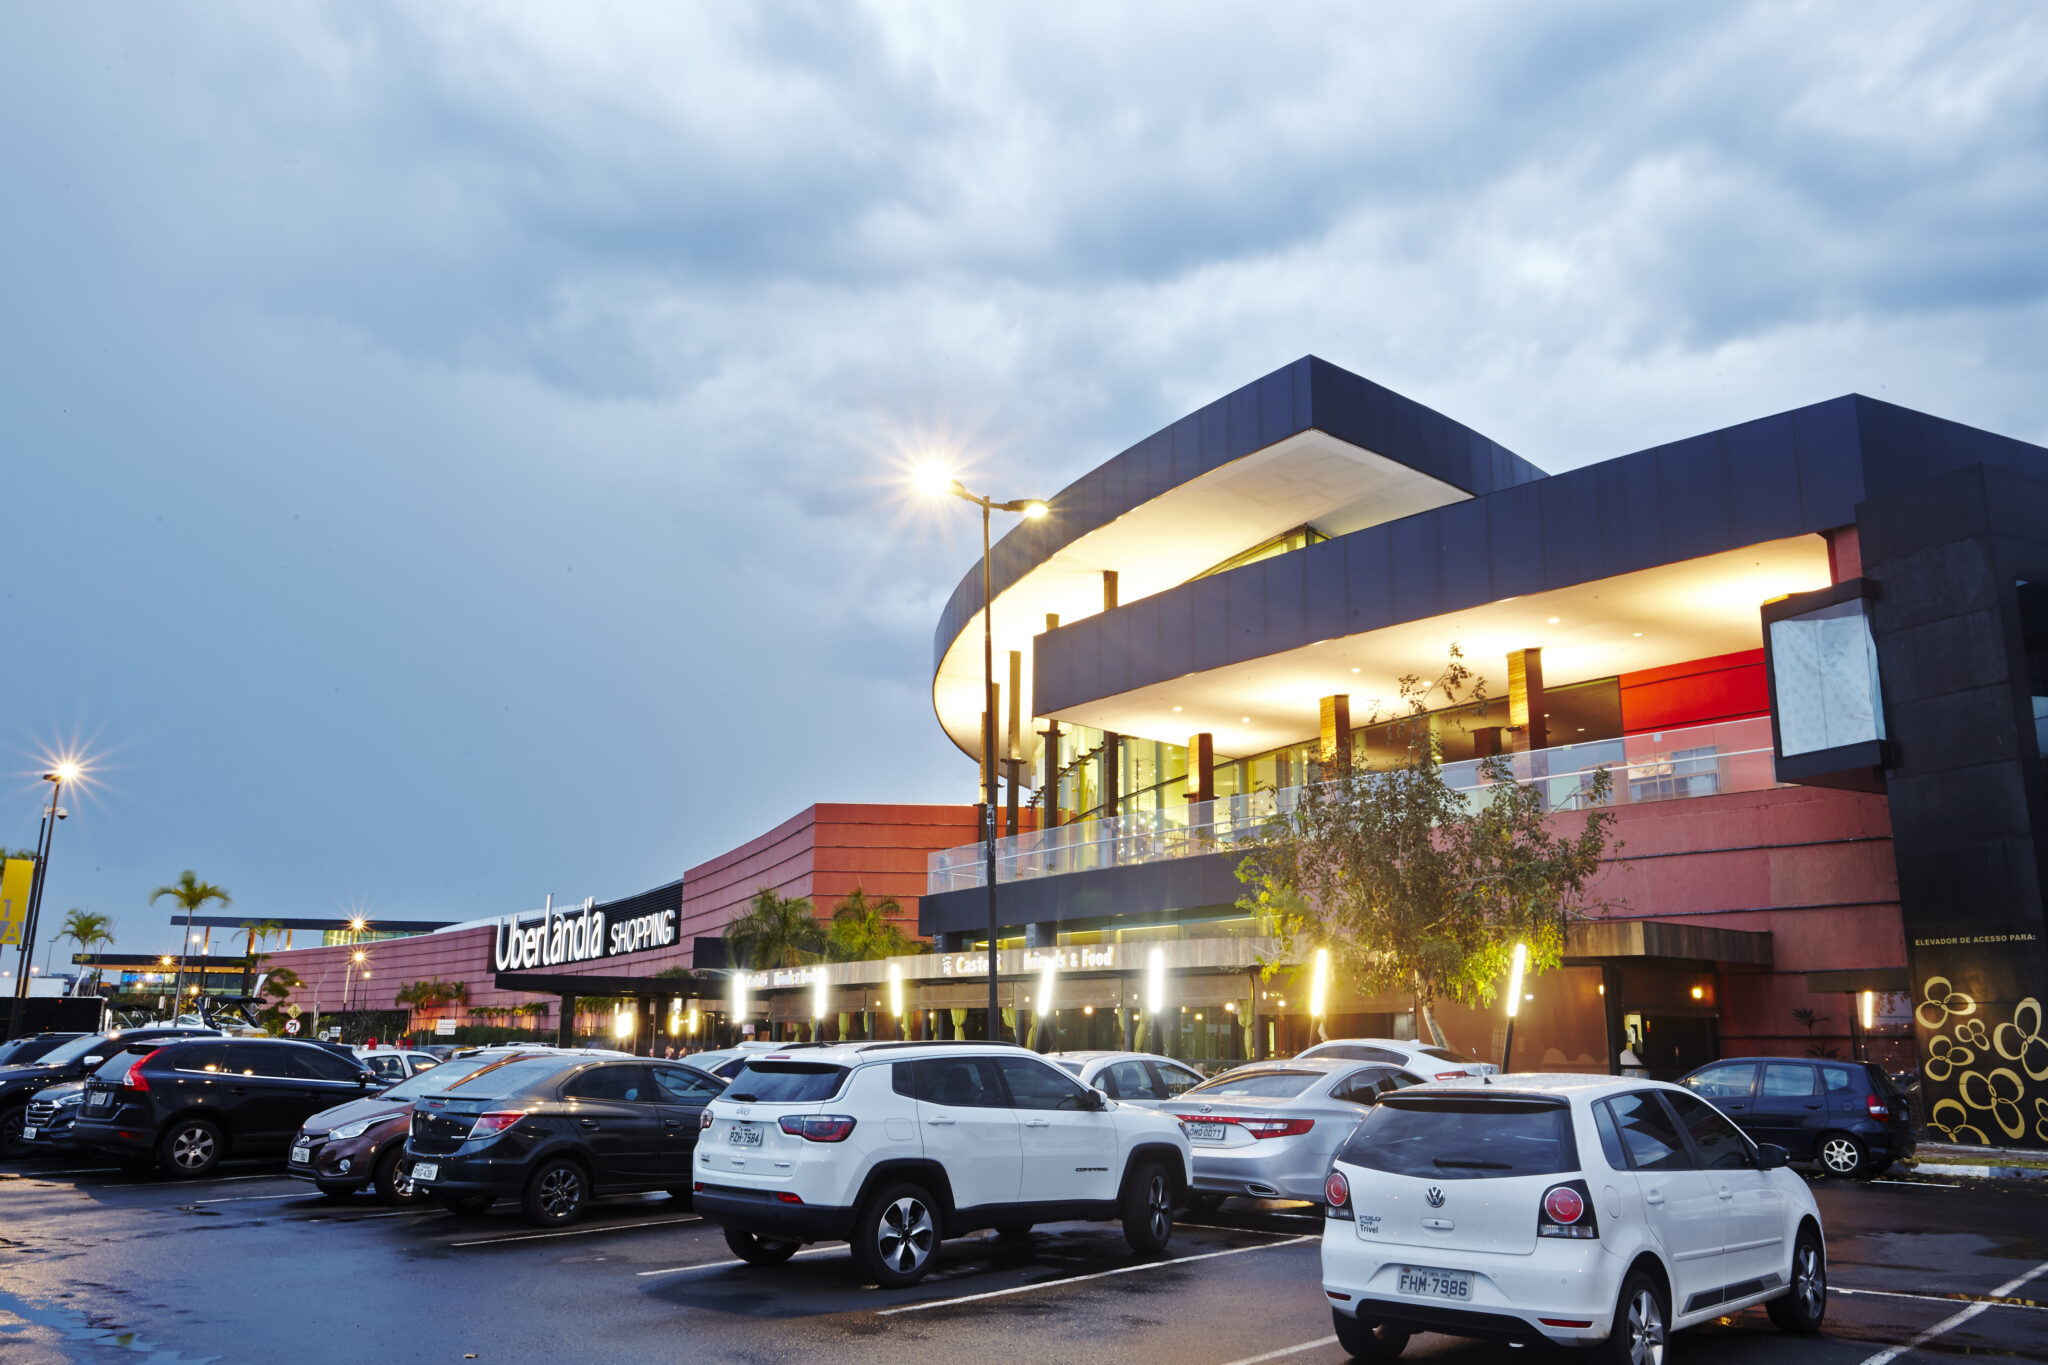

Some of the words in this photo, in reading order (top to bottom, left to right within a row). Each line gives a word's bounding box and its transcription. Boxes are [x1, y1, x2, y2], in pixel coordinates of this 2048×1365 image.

[3, 898, 12, 919] 1
[0, 920, 22, 944] A
[609, 909, 676, 956] SHOPPING
[1915, 937, 1958, 946] ELEVADOR
[1973, 934, 2008, 943] ACESSO
[2009, 933, 2036, 941] PARA:
[1070, 953, 1079, 968] &
[1082, 946, 1113, 967] Food
[1360, 1224, 1379, 1234] Trivel
